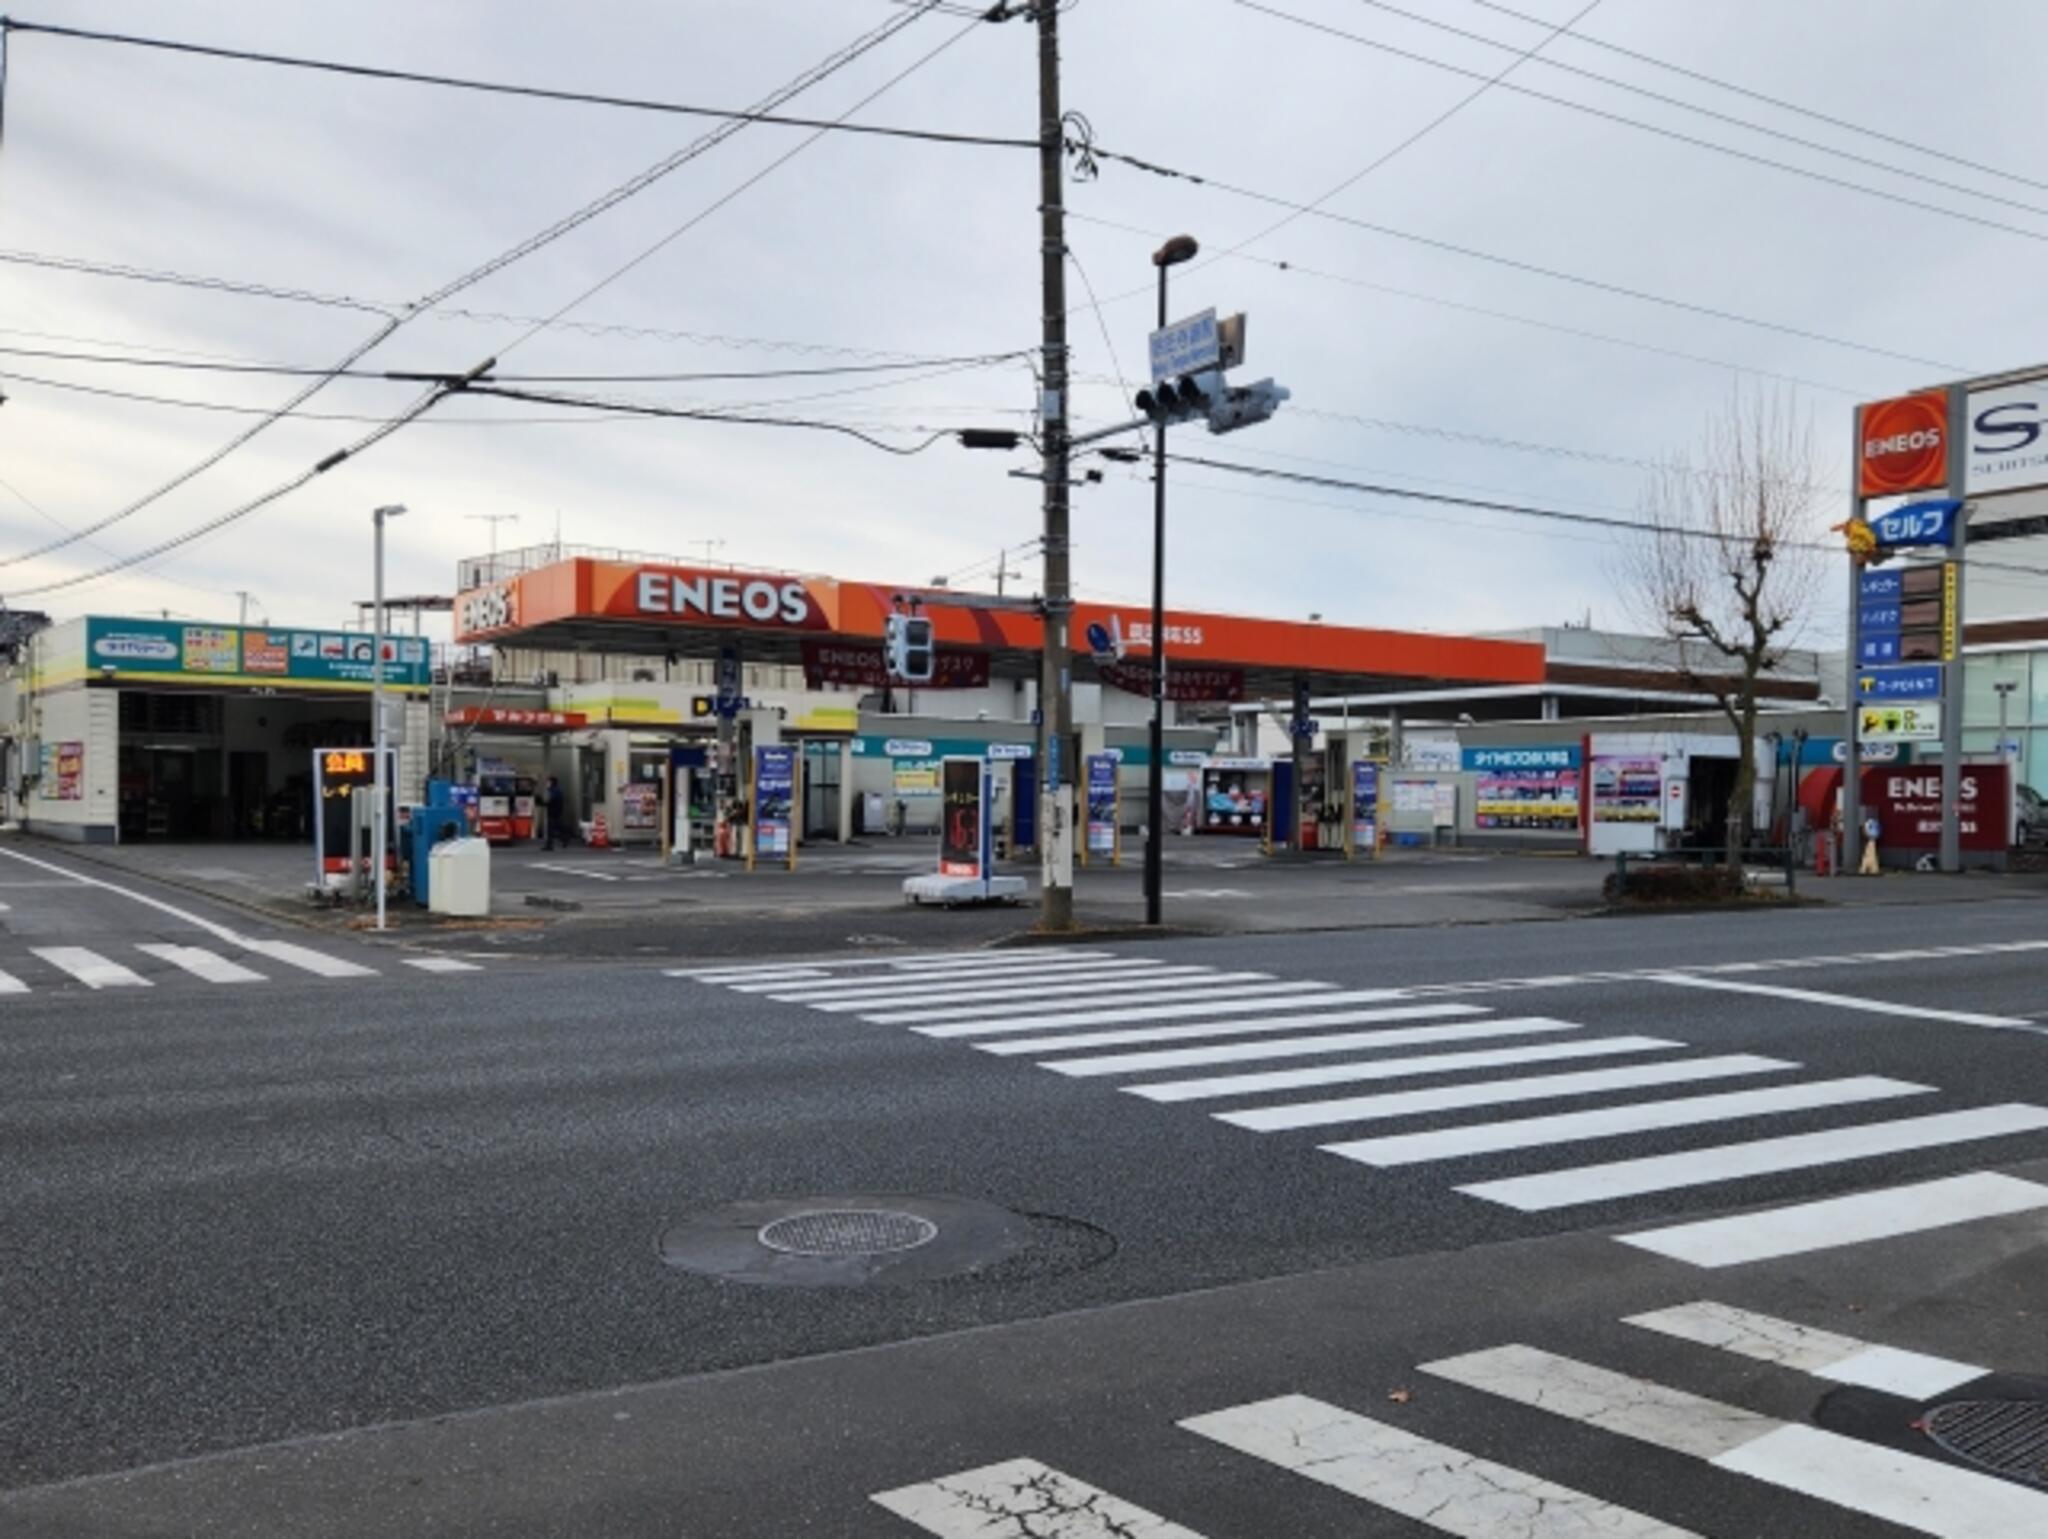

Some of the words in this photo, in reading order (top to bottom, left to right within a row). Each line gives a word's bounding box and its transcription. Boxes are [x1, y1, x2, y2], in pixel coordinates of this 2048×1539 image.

[1865, 428, 1940, 458] ENEOS
[1880, 511, 1943, 541] セルフ
[639, 571, 808, 623] ENEOS
[1861, 579, 1898, 593] レギュラー
[463, 588, 511, 631] ENEOS
[1861, 610, 1899, 624] ハイオク
[819, 649, 881, 671] ENEOS
[326, 753, 365, 772] 会員
[1888, 777, 1978, 799] ENES
